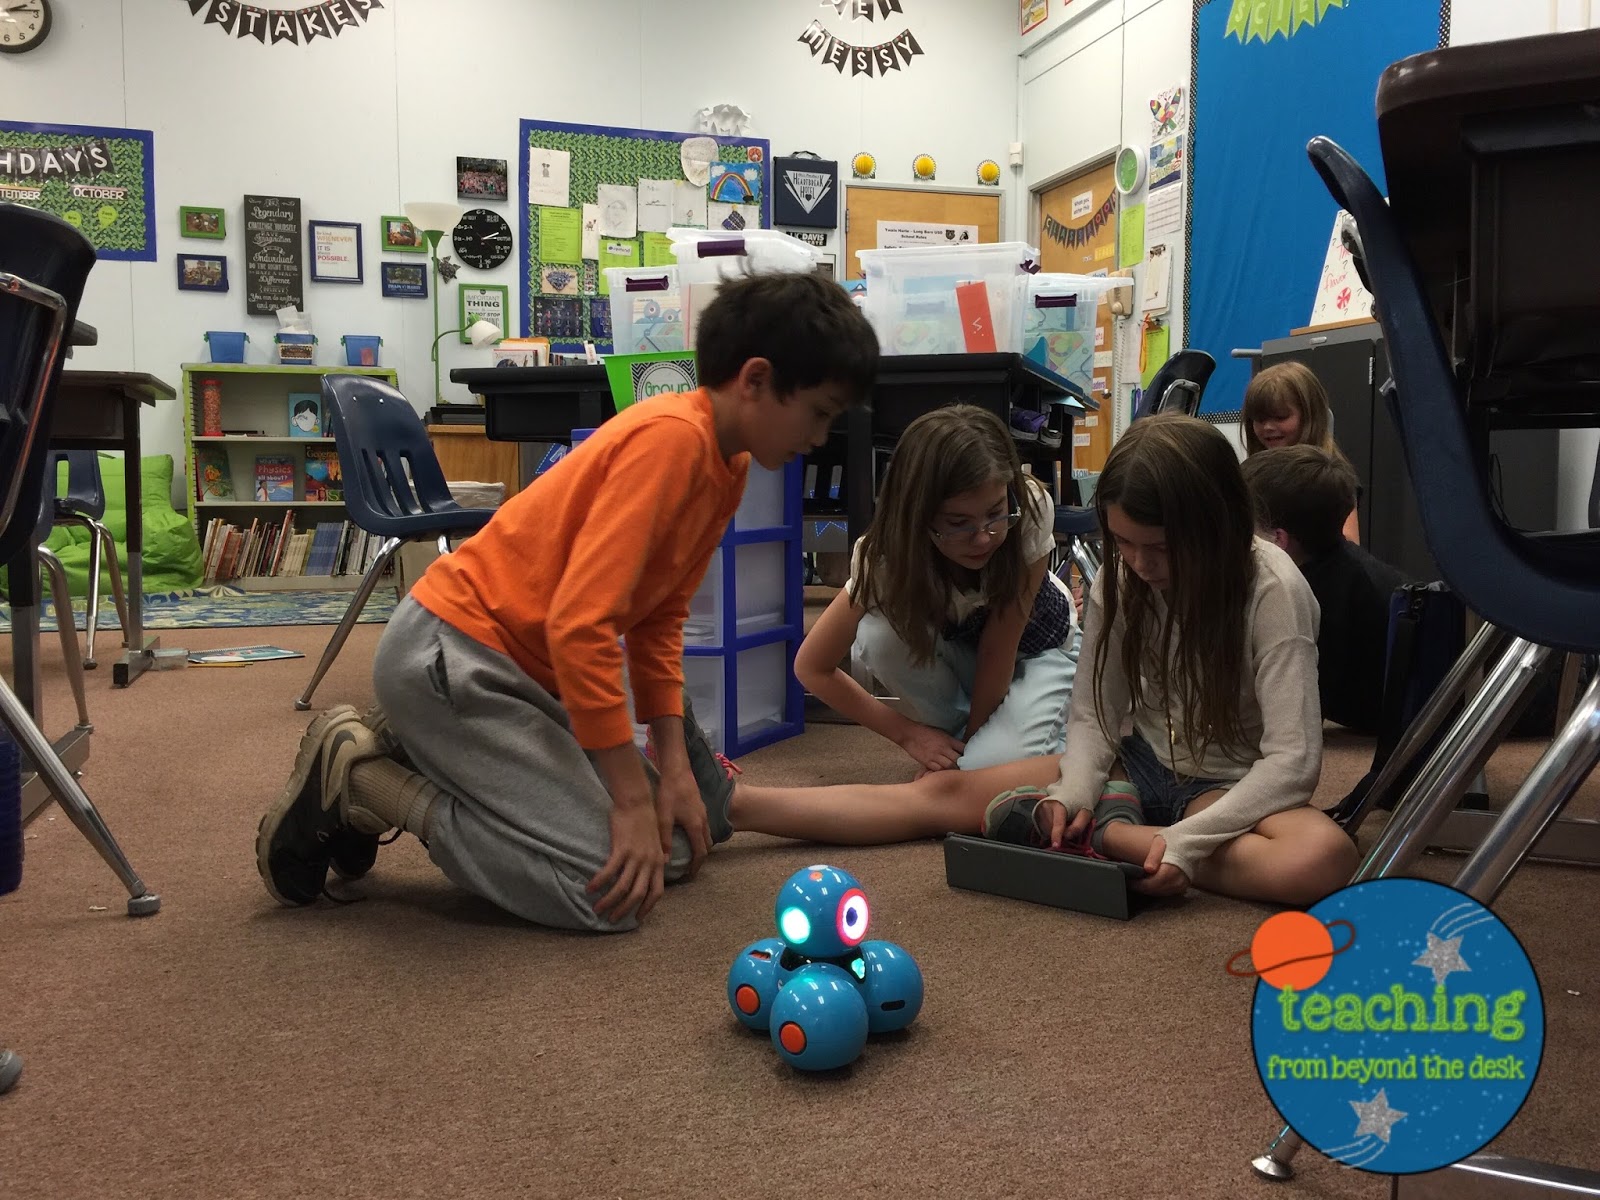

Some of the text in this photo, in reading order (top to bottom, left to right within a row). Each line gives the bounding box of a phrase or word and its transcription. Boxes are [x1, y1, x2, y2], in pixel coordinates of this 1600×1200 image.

[33, 10, 39, 19] 3
[28, 23, 35, 31] 4
[3, 34, 11, 42] 6
[803, 24, 914, 70] MESSY
[793, 173, 824, 187] HEARTBREAK
[73, 187, 125, 200] OCTOBER
[800, 186, 815, 199] HOTEL
[317, 235, 353, 243] WHENEVER
[802, 233, 825, 241] DAVIS
[258, 465, 292, 473] Physics
